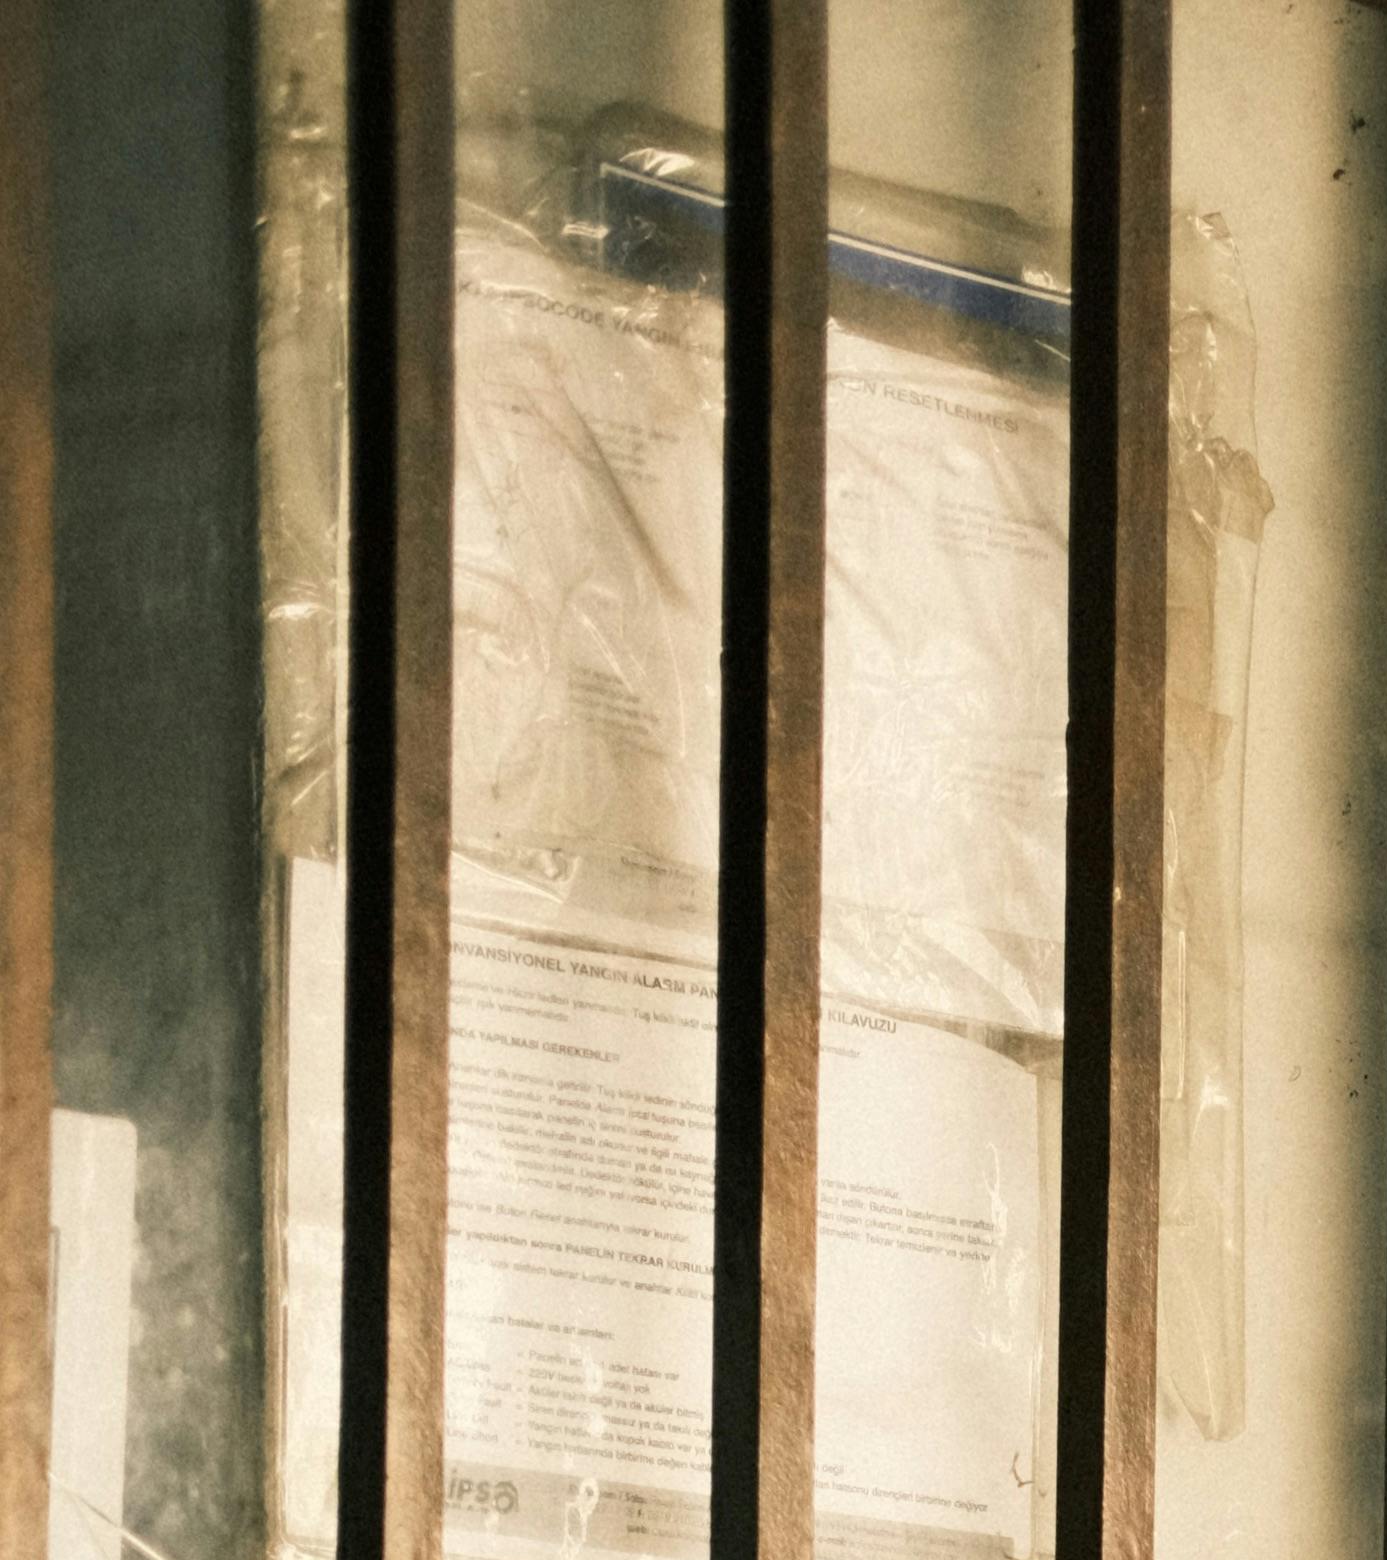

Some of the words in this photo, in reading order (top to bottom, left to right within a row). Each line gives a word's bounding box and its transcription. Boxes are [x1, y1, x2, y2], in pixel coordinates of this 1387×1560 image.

[451, 939, 566, 973] NVANSİYONEL
[569, 961, 628, 984] YANGIN
[827, 1008, 896, 1034] KILAVUZU
[530, 1238, 563, 1253] sonra
[618, 1249, 665, 1268] TEKRAR
